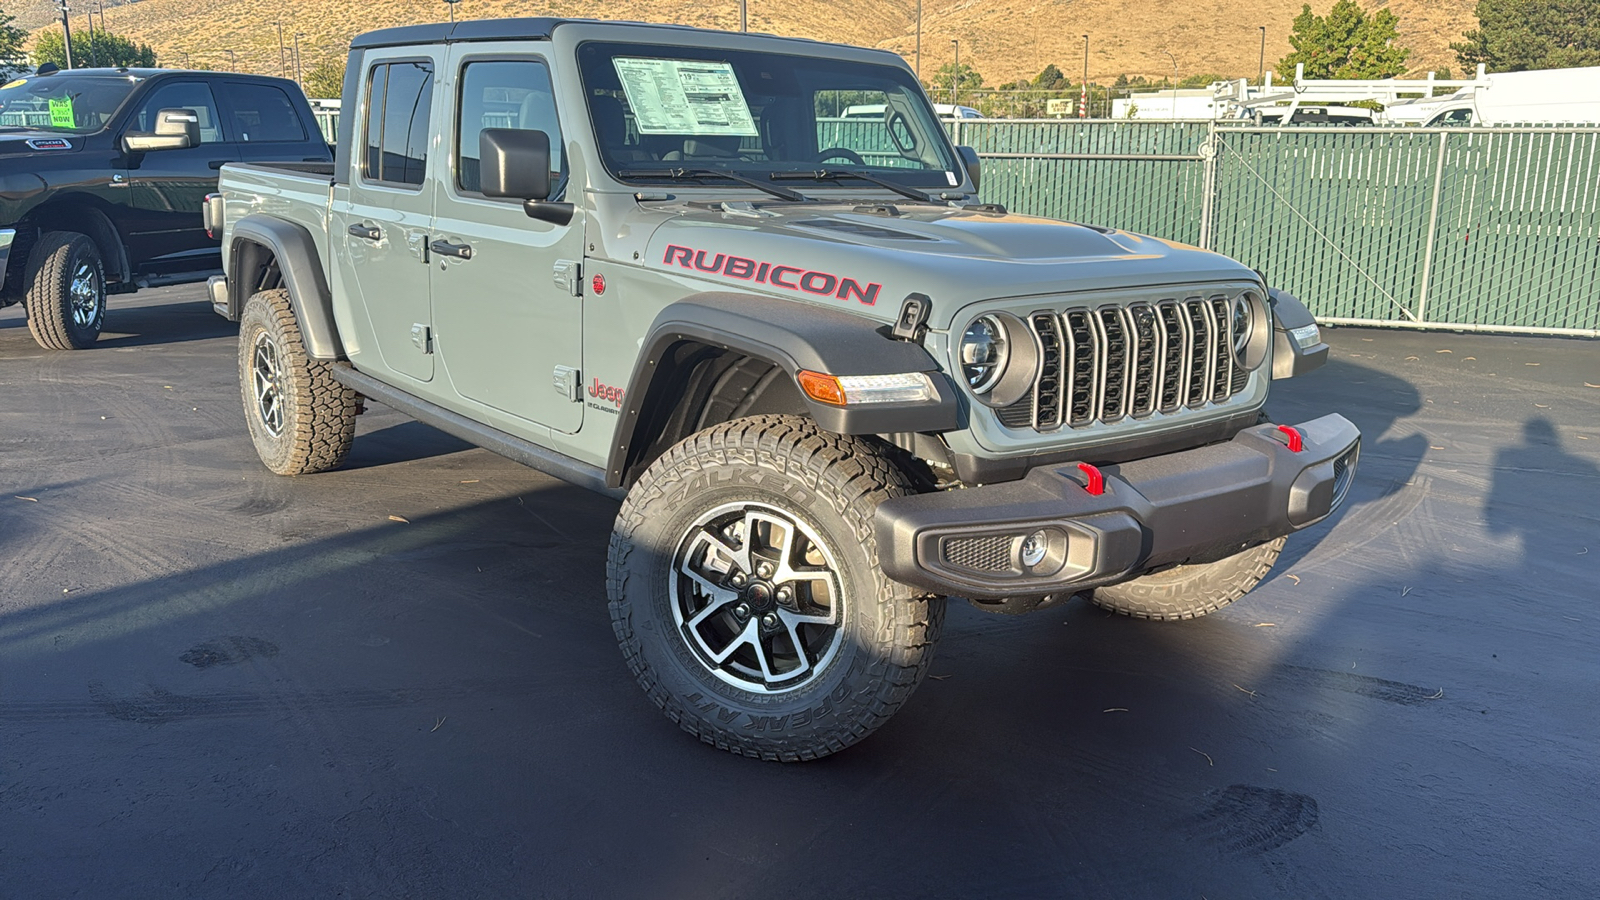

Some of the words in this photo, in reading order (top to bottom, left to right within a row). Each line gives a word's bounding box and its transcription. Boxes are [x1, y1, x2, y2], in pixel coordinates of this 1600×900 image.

[663, 244, 882, 306] RUBICON
[588, 377, 625, 408] Jeep
[593, 403, 620, 415] GLADIAT
[663, 468, 817, 511] FALKEN
[743, 612, 875, 733] WILDPEAK
